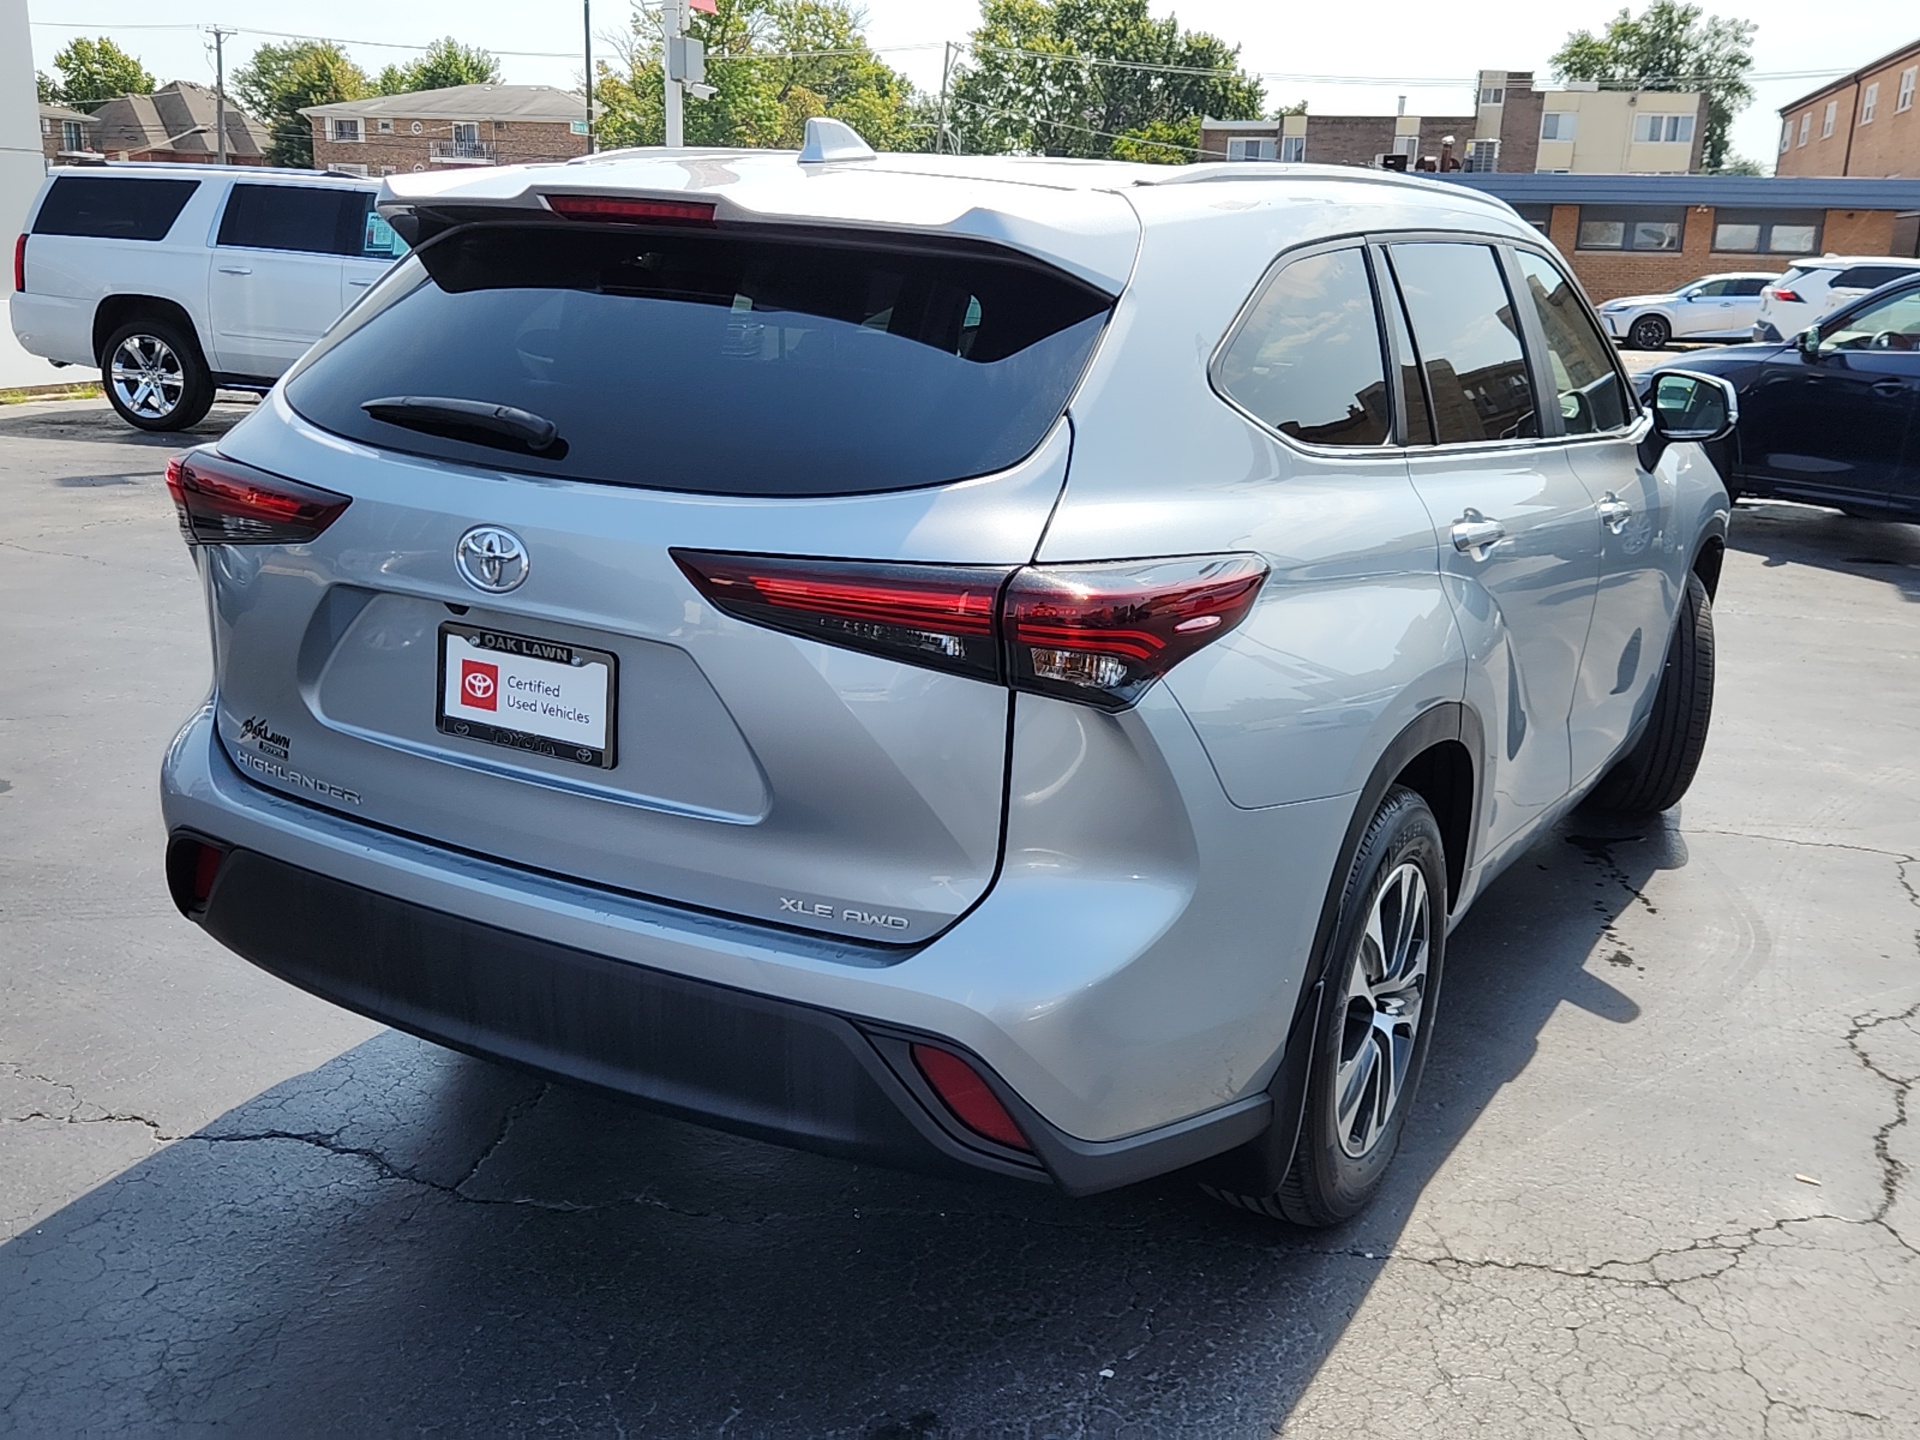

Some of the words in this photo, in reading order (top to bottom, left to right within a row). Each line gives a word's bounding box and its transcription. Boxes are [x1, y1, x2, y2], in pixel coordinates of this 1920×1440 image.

[485, 635, 517, 652] OAK
[522, 641, 568, 661] LAWN
[507, 675, 561, 697] Certified
[507, 695, 537, 712] Used
[541, 702, 590, 724] Vehicles
[490, 728, 556, 757] TOYOTA
[237, 750, 363, 804] HIGHLANDER
[779, 897, 834, 919] XLE
[842, 909, 910, 930] AWD
